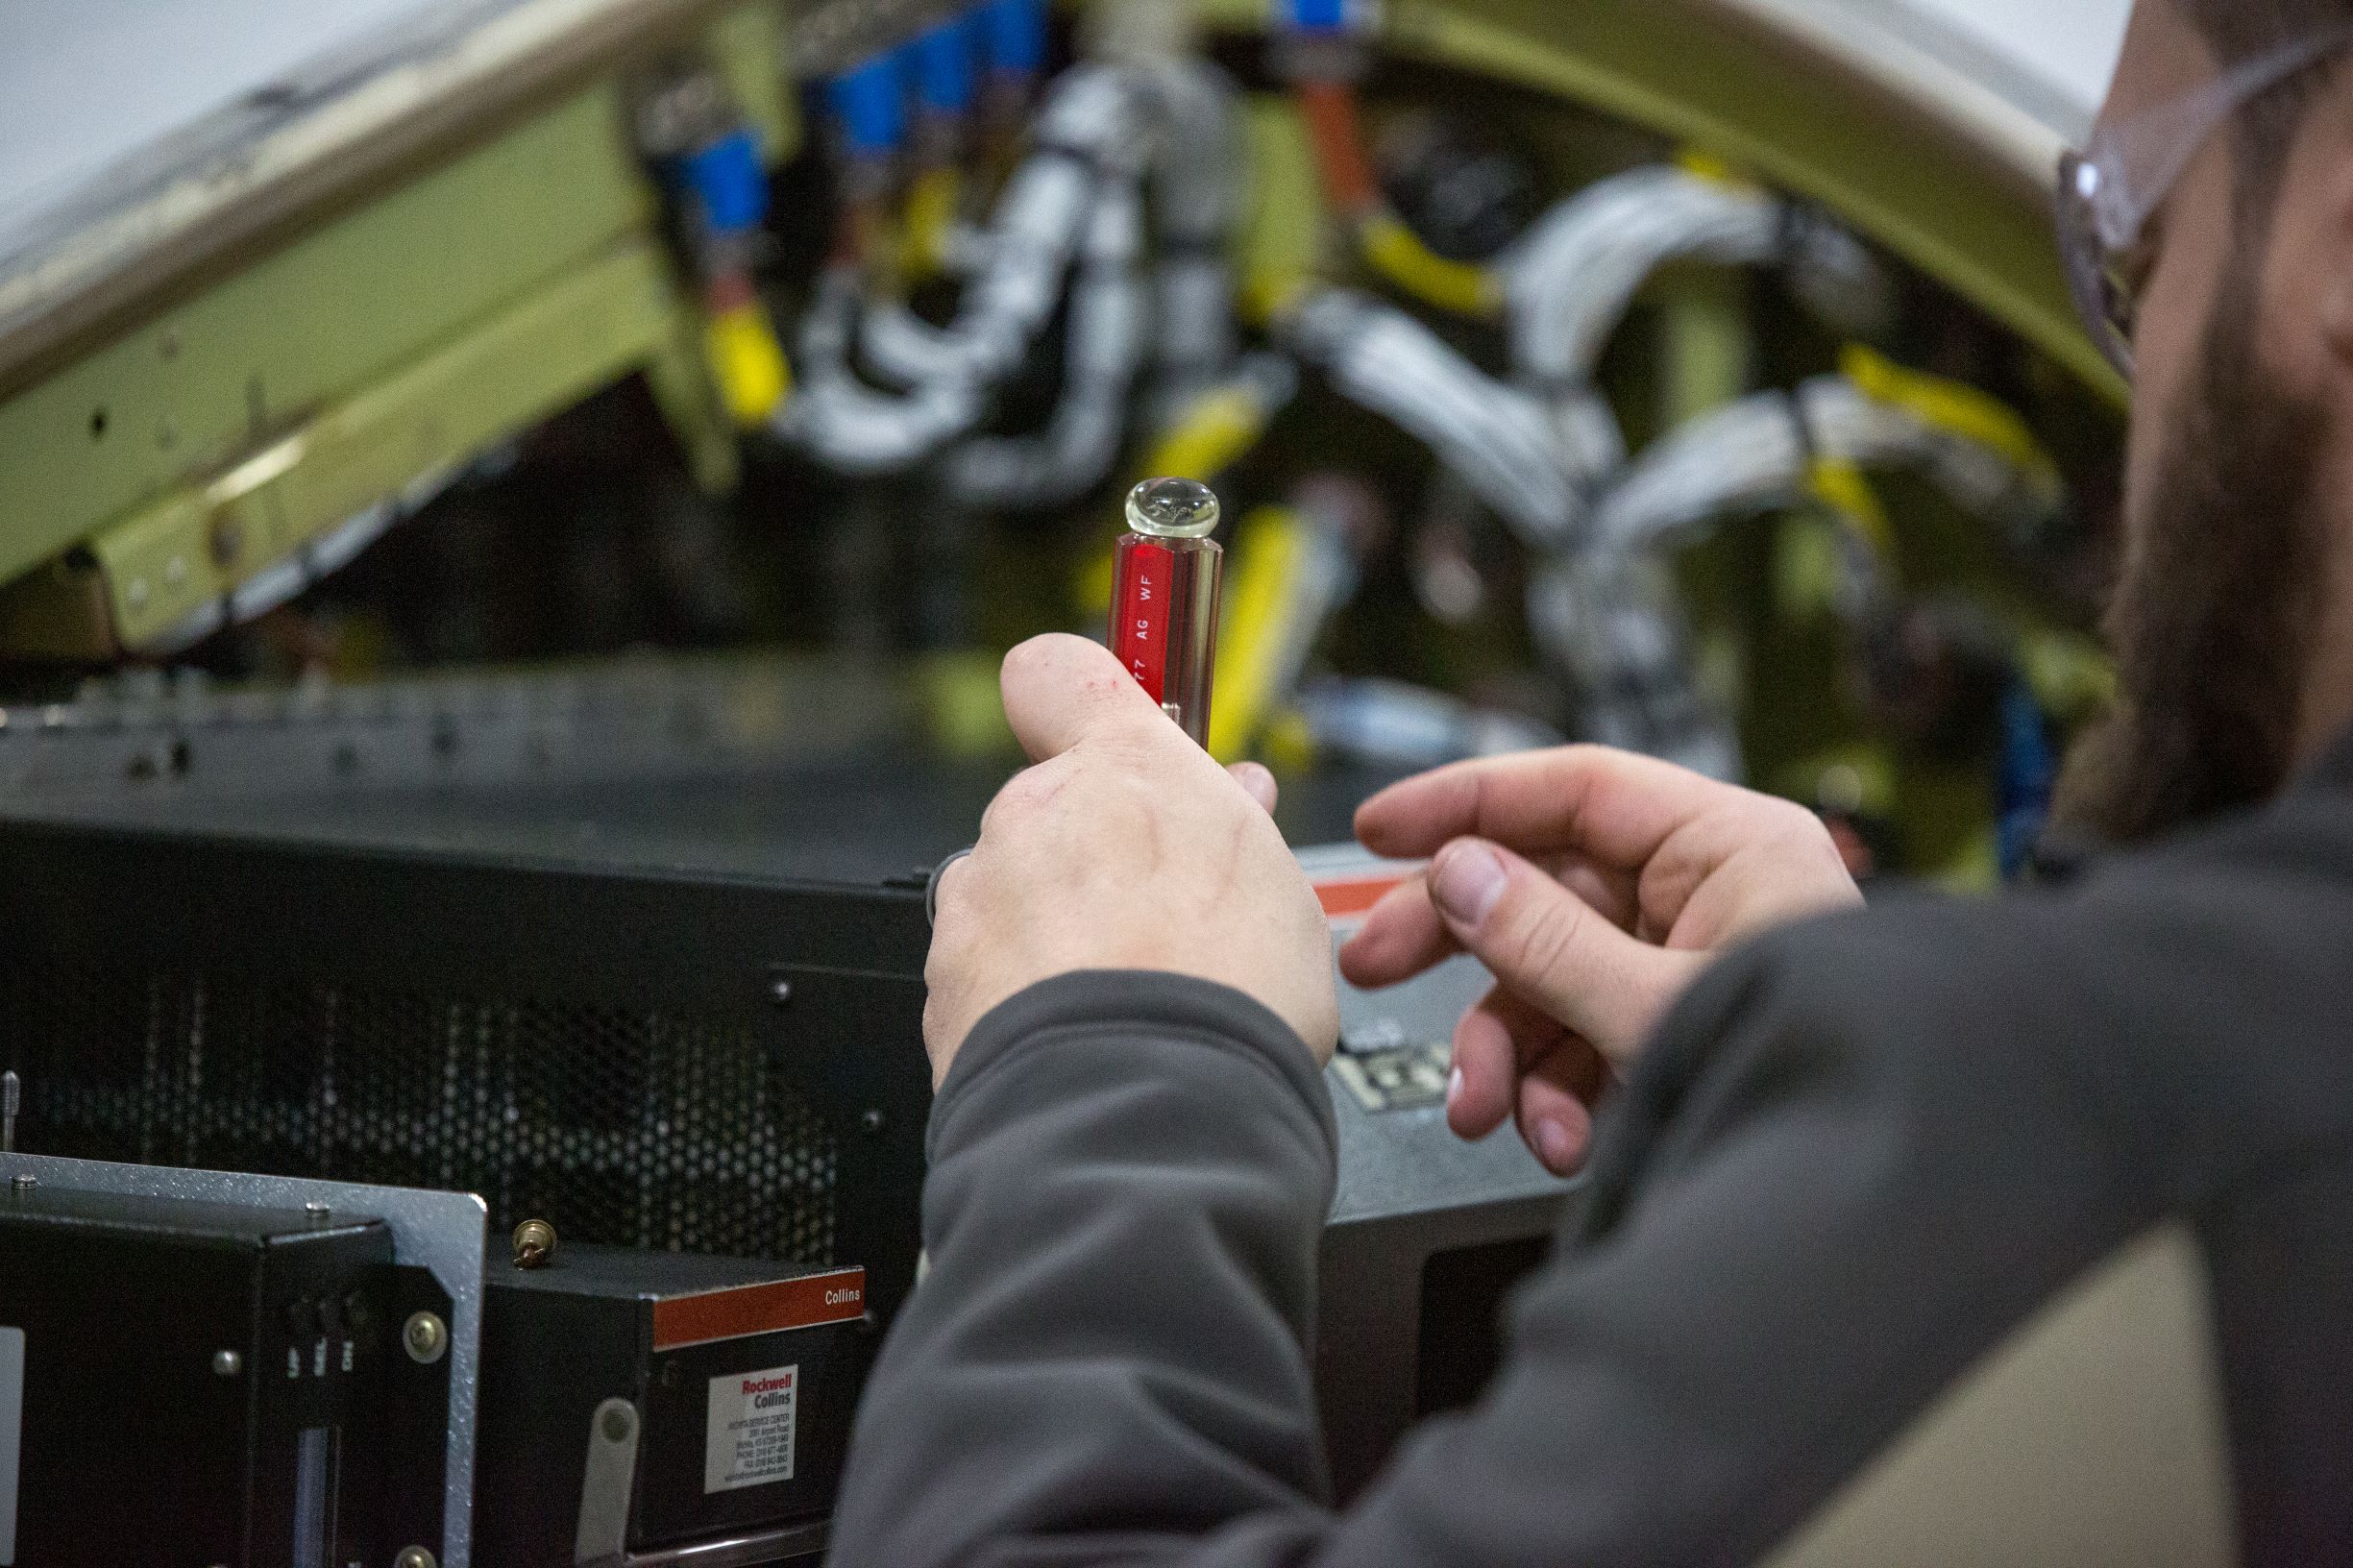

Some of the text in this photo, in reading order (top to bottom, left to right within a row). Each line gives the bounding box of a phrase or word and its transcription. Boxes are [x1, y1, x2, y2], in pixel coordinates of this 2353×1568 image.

[1140, 575, 1153, 601] WF
[1136, 619, 1149, 641] AG
[824, 1288, 861, 1306] Collins
[742, 1373, 793, 1395] Rockwell
[754, 1392, 791, 1409] Collins
